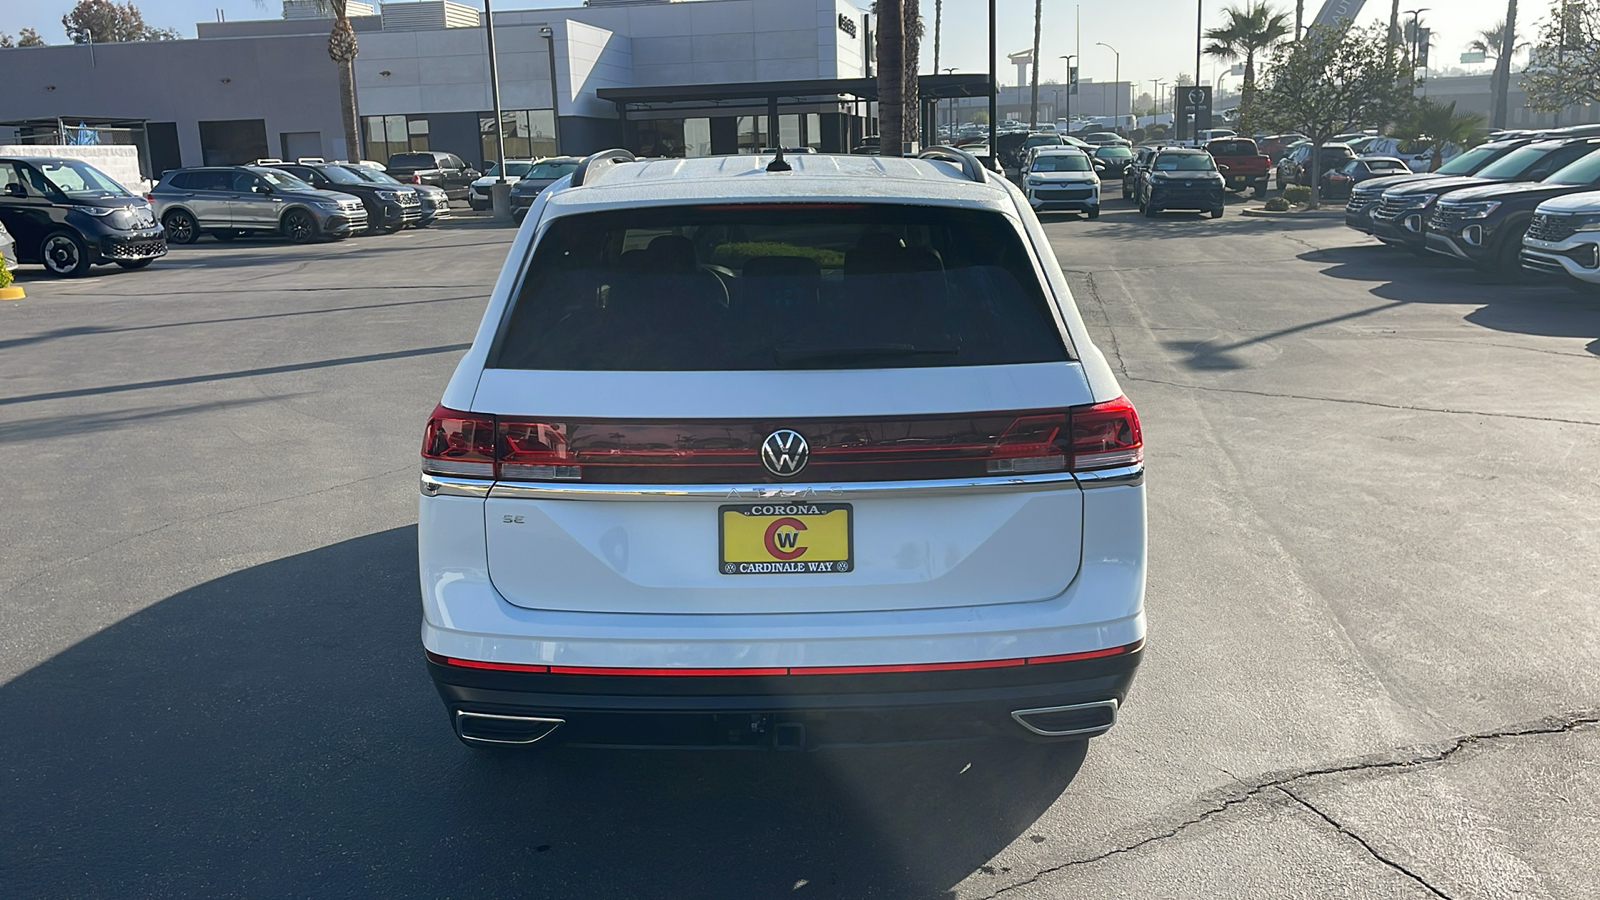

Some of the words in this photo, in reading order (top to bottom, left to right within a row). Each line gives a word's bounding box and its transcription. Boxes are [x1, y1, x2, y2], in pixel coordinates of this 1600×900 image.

[726, 486, 843, 498] ATLAS
[751, 505, 820, 516] CORONA
[502, 514, 525, 524] SE
[739, 562, 806, 573] CARDINALE
[808, 561, 834, 572] WAY
